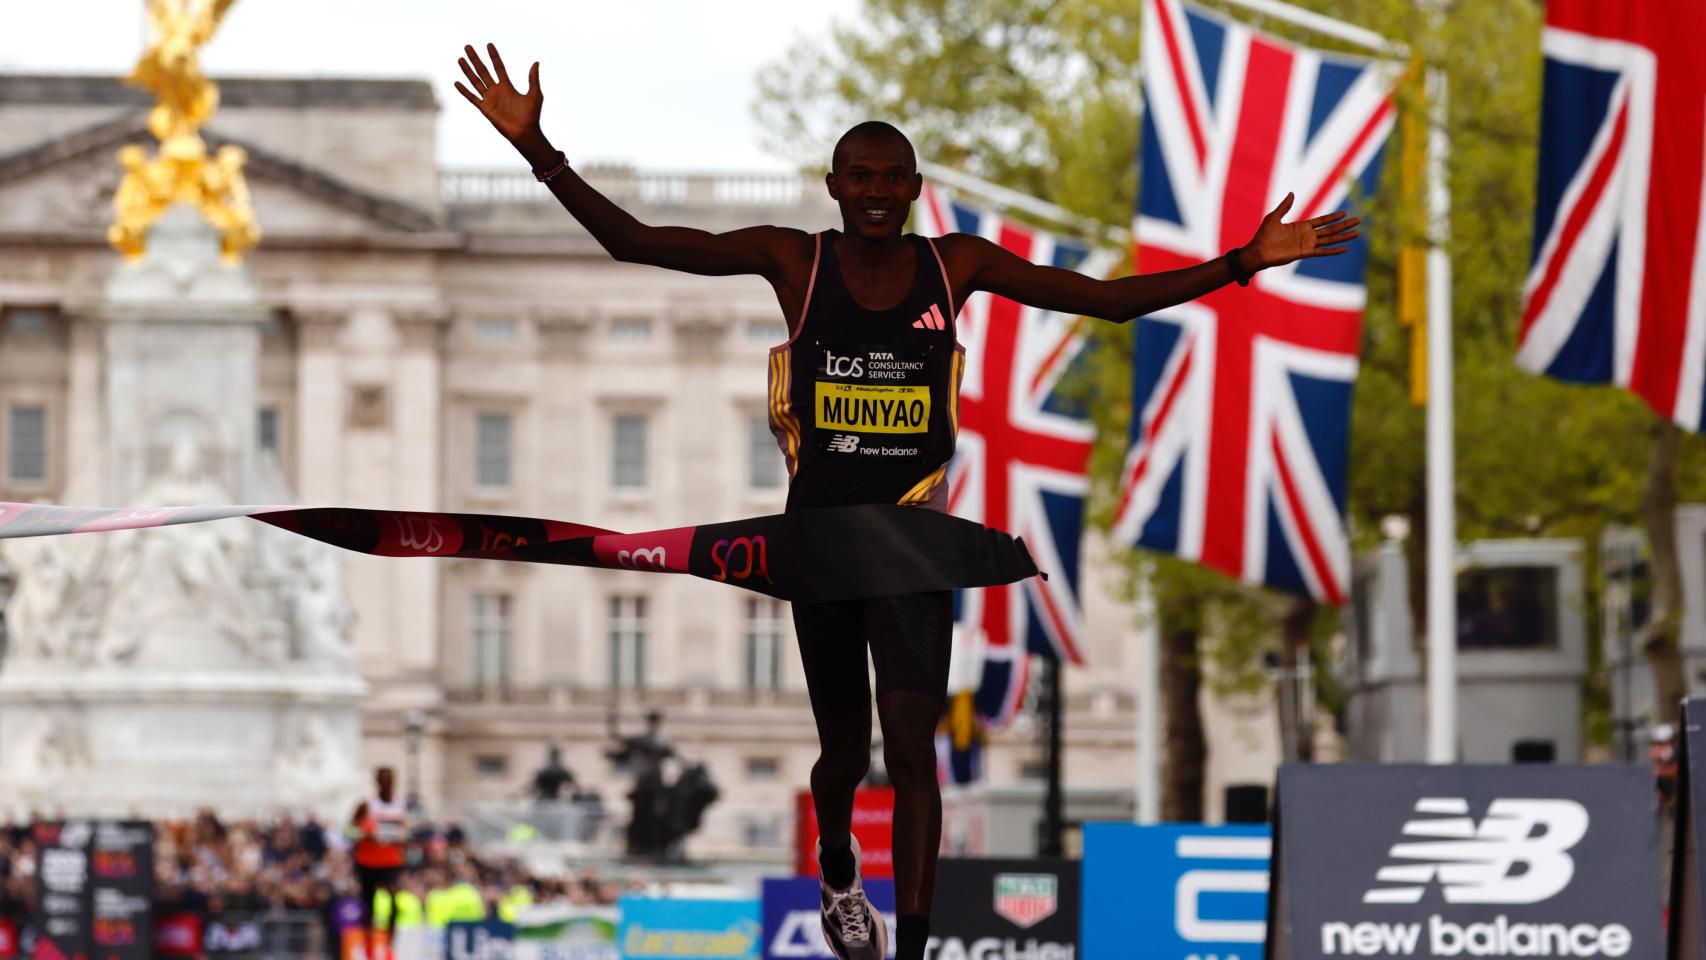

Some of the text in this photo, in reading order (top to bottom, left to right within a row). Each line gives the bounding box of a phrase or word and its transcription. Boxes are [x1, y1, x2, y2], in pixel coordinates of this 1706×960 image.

[868, 352, 894, 361] TATA
[826, 350, 864, 378] tcs
[868, 361, 924, 371] CONSULTANCY
[868, 371, 906, 379] SERVICES
[823, 396, 924, 428] MUNYAO
[860, 446, 918, 456] new balance
[1321, 913, 1633, 957] new balance
